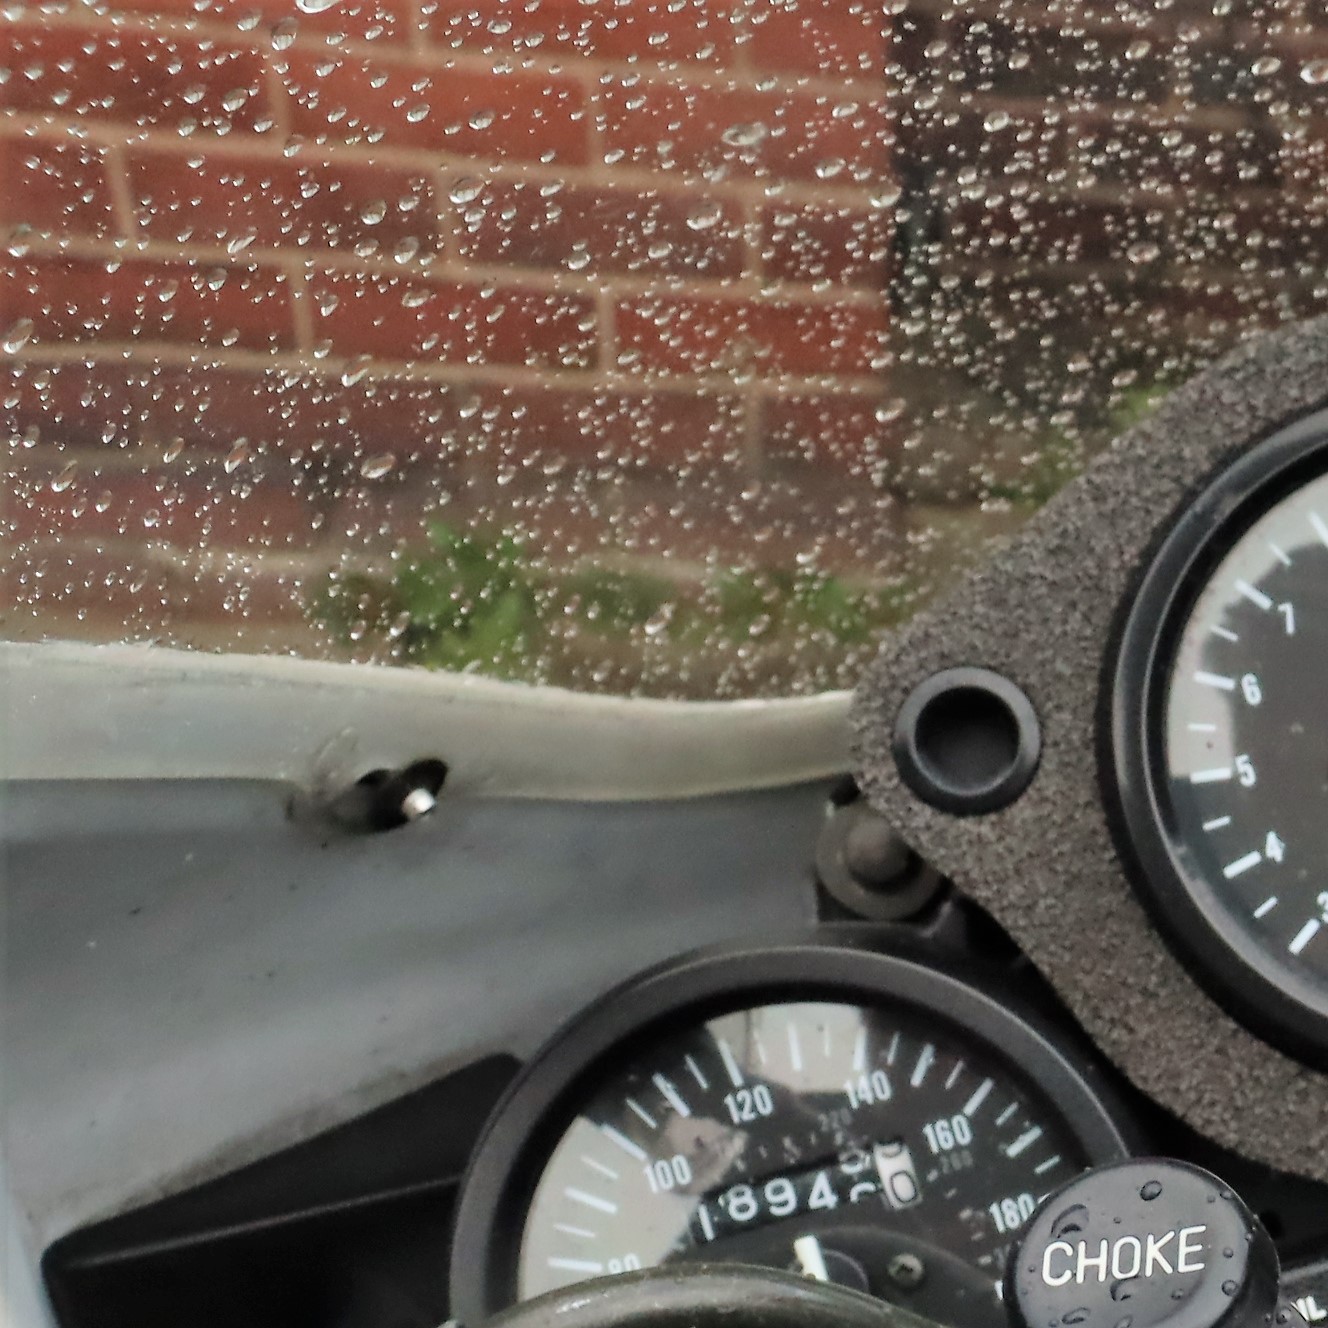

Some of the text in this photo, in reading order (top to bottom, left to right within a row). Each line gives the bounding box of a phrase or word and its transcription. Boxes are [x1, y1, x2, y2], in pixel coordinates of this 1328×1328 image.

[1277, 601, 1295, 636] 7
[1241, 672, 1262, 706] 6
[1234, 753, 1257, 787] 5
[1264, 830, 1286, 863] 4
[723, 1083, 775, 1126] 120
[844, 1069, 894, 1111] 140
[922, 1113, 974, 1155] 160
[642, 1153, 693, 1195] 100
[988, 1192, 1036, 1234] 180
[1041, 1224, 1208, 1288] CHOKE
